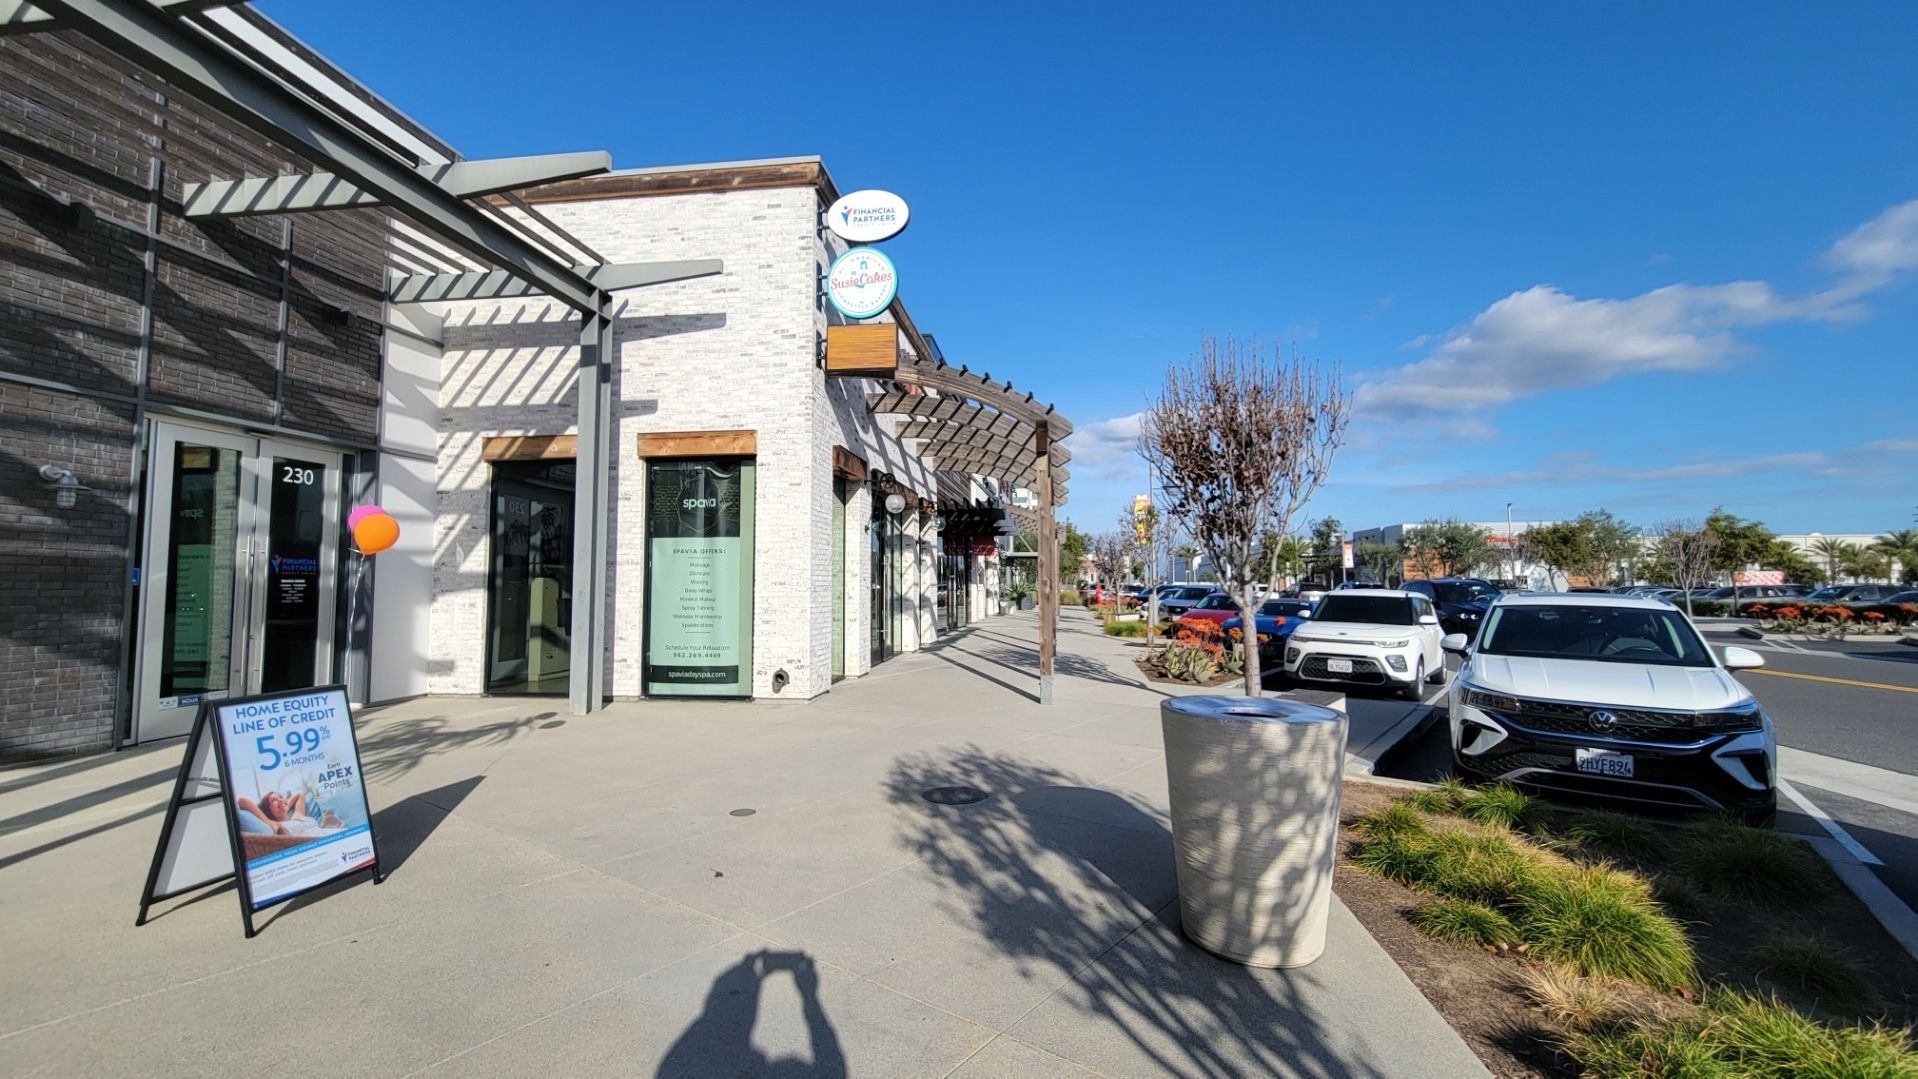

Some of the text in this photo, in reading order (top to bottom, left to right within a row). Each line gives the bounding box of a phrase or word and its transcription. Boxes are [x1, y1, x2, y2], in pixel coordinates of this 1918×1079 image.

[853, 207, 896, 215] FINANCIAL
[853, 214, 896, 223] PARTNERS
[830, 271, 893, 290] SusieCakes
[282, 466, 314, 485] 230
[682, 496, 716, 510] spavia
[668, 670, 726, 679] spaviadayspa.com
[235, 695, 329, 719] HOME EQUITY
[232, 708, 336, 735] LINE OF CREDIT
[284, 752, 325, 768] 6 MONTHS
[327, 761, 341, 770] Earn
[318, 765, 354, 784] APEX
[323, 778, 351, 791] Points
